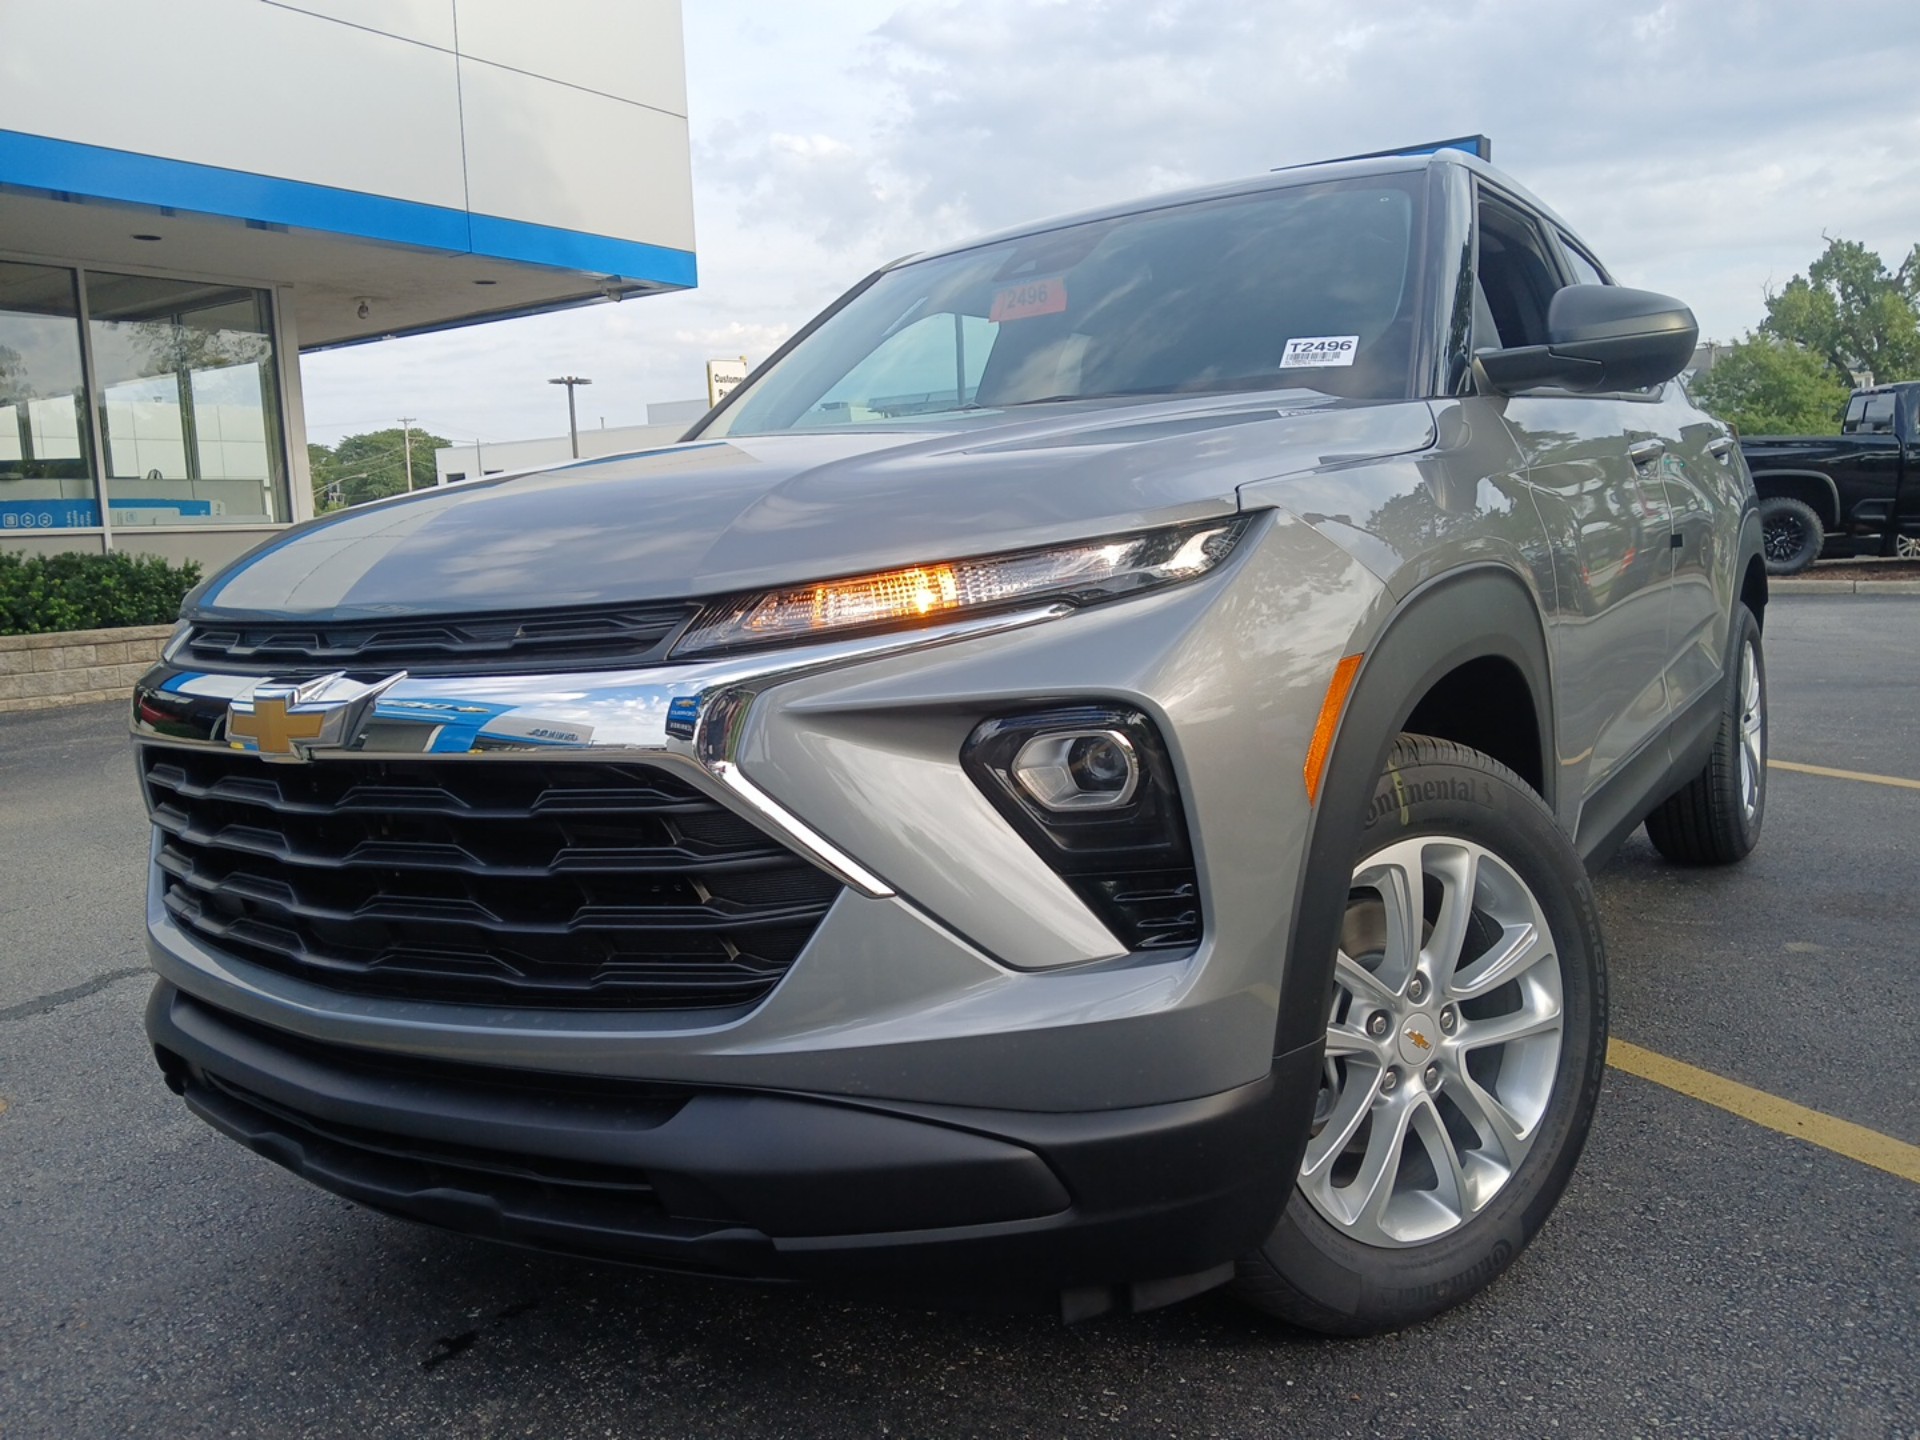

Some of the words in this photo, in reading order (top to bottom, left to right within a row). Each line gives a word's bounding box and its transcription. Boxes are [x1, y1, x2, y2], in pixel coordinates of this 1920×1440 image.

[1007, 284, 1048, 309] 2496
[1290, 340, 1353, 353] T2496
[714, 374, 745, 383] Custome
